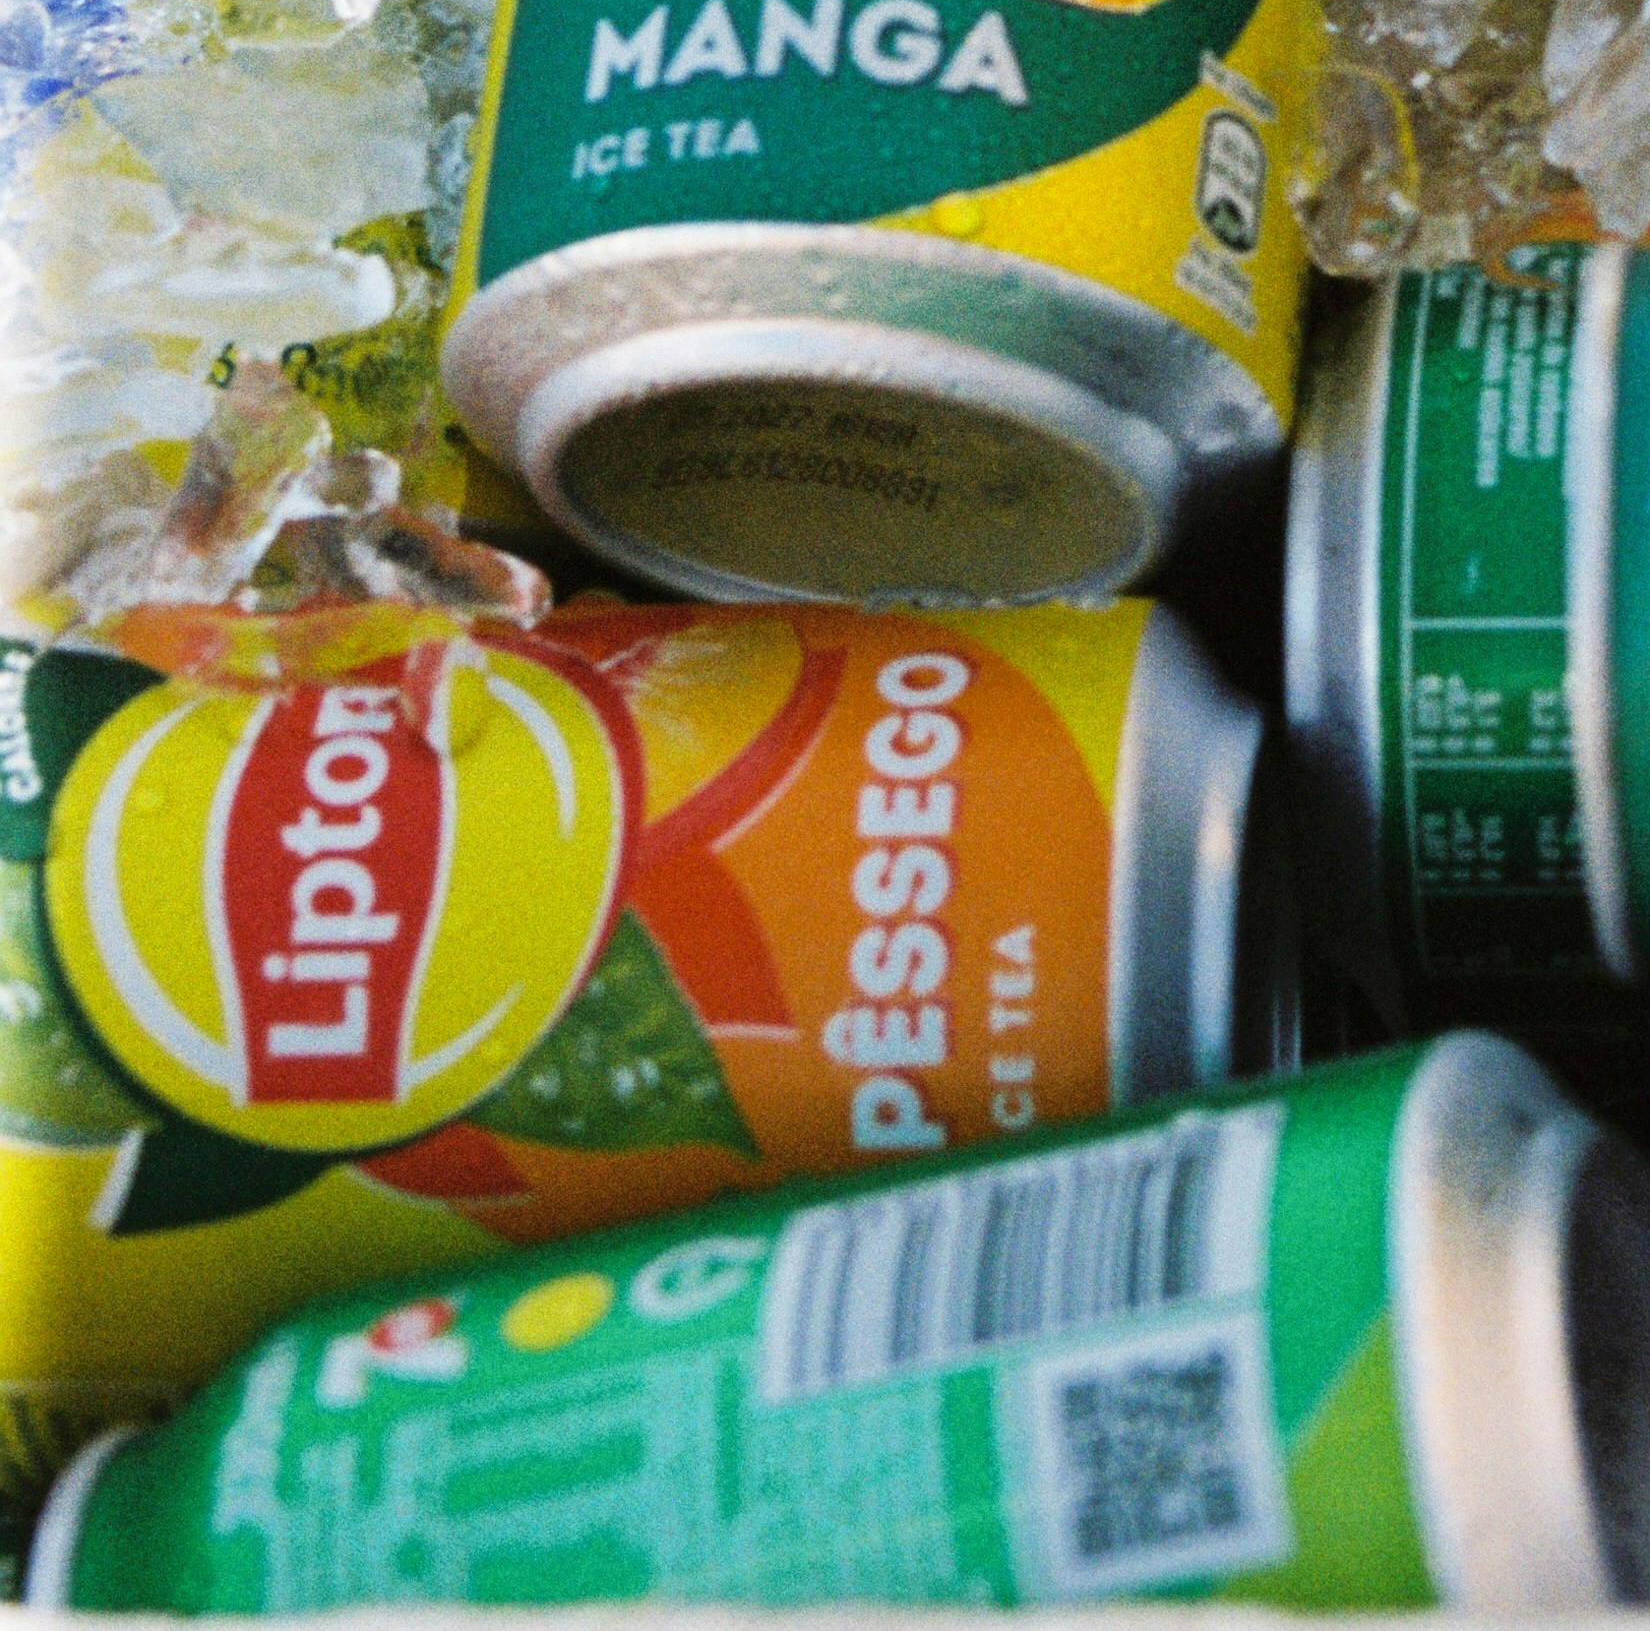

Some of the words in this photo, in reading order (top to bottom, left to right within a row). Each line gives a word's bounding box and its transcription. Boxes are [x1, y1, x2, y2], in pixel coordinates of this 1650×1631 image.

[572, 128, 648, 181] ICE
[661, 117, 761, 162] TEA
[266, 685, 404, 1060] Lipton
[822, 647, 976, 1152] PÊSSEGO
[988, 922, 1038, 1038] TEA
[988, 1052, 1038, 1130] CE
